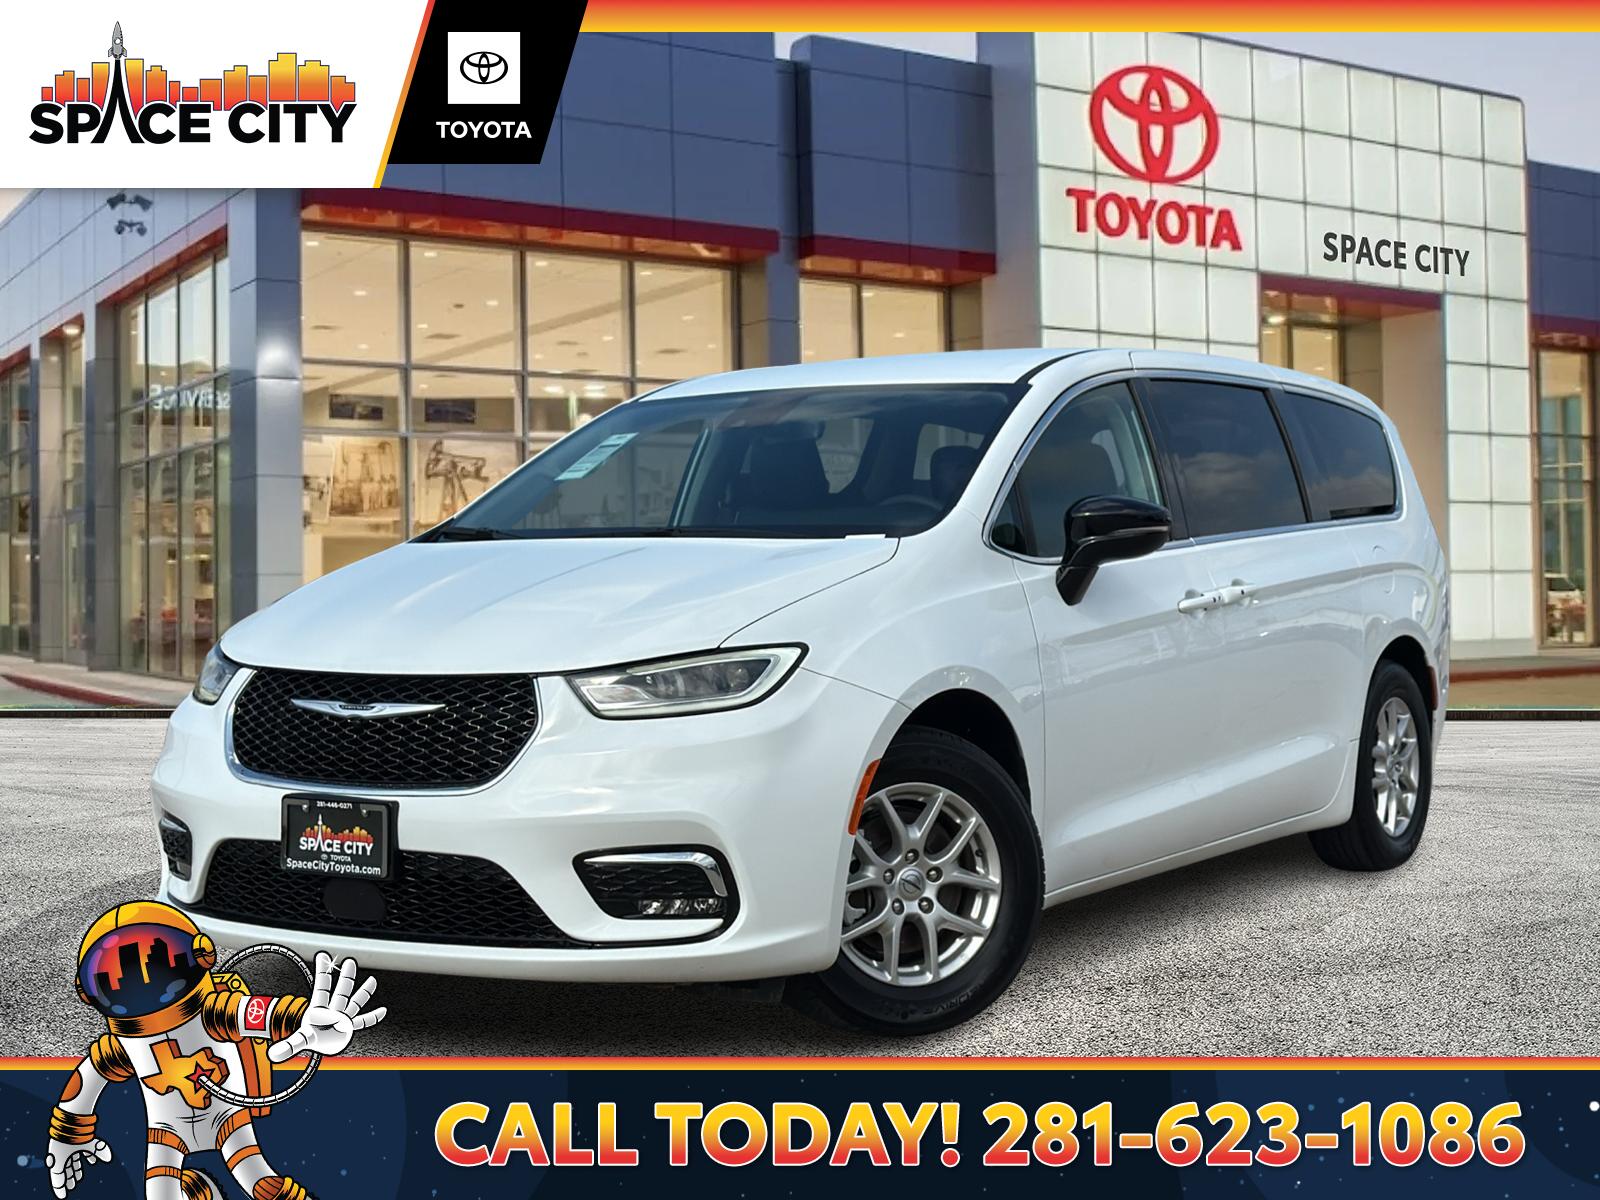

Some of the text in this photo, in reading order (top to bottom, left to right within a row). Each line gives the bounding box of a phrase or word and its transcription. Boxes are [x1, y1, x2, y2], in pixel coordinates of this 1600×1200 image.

[1066, 188, 1242, 251] TOYOTA
[1323, 232, 1470, 277] SPACE CITY
[299, 835, 373, 855] SPACE CITY
[286, 858, 380, 874] SpaceCityToyota.com
[330, 854, 351, 862] TOYOTA
